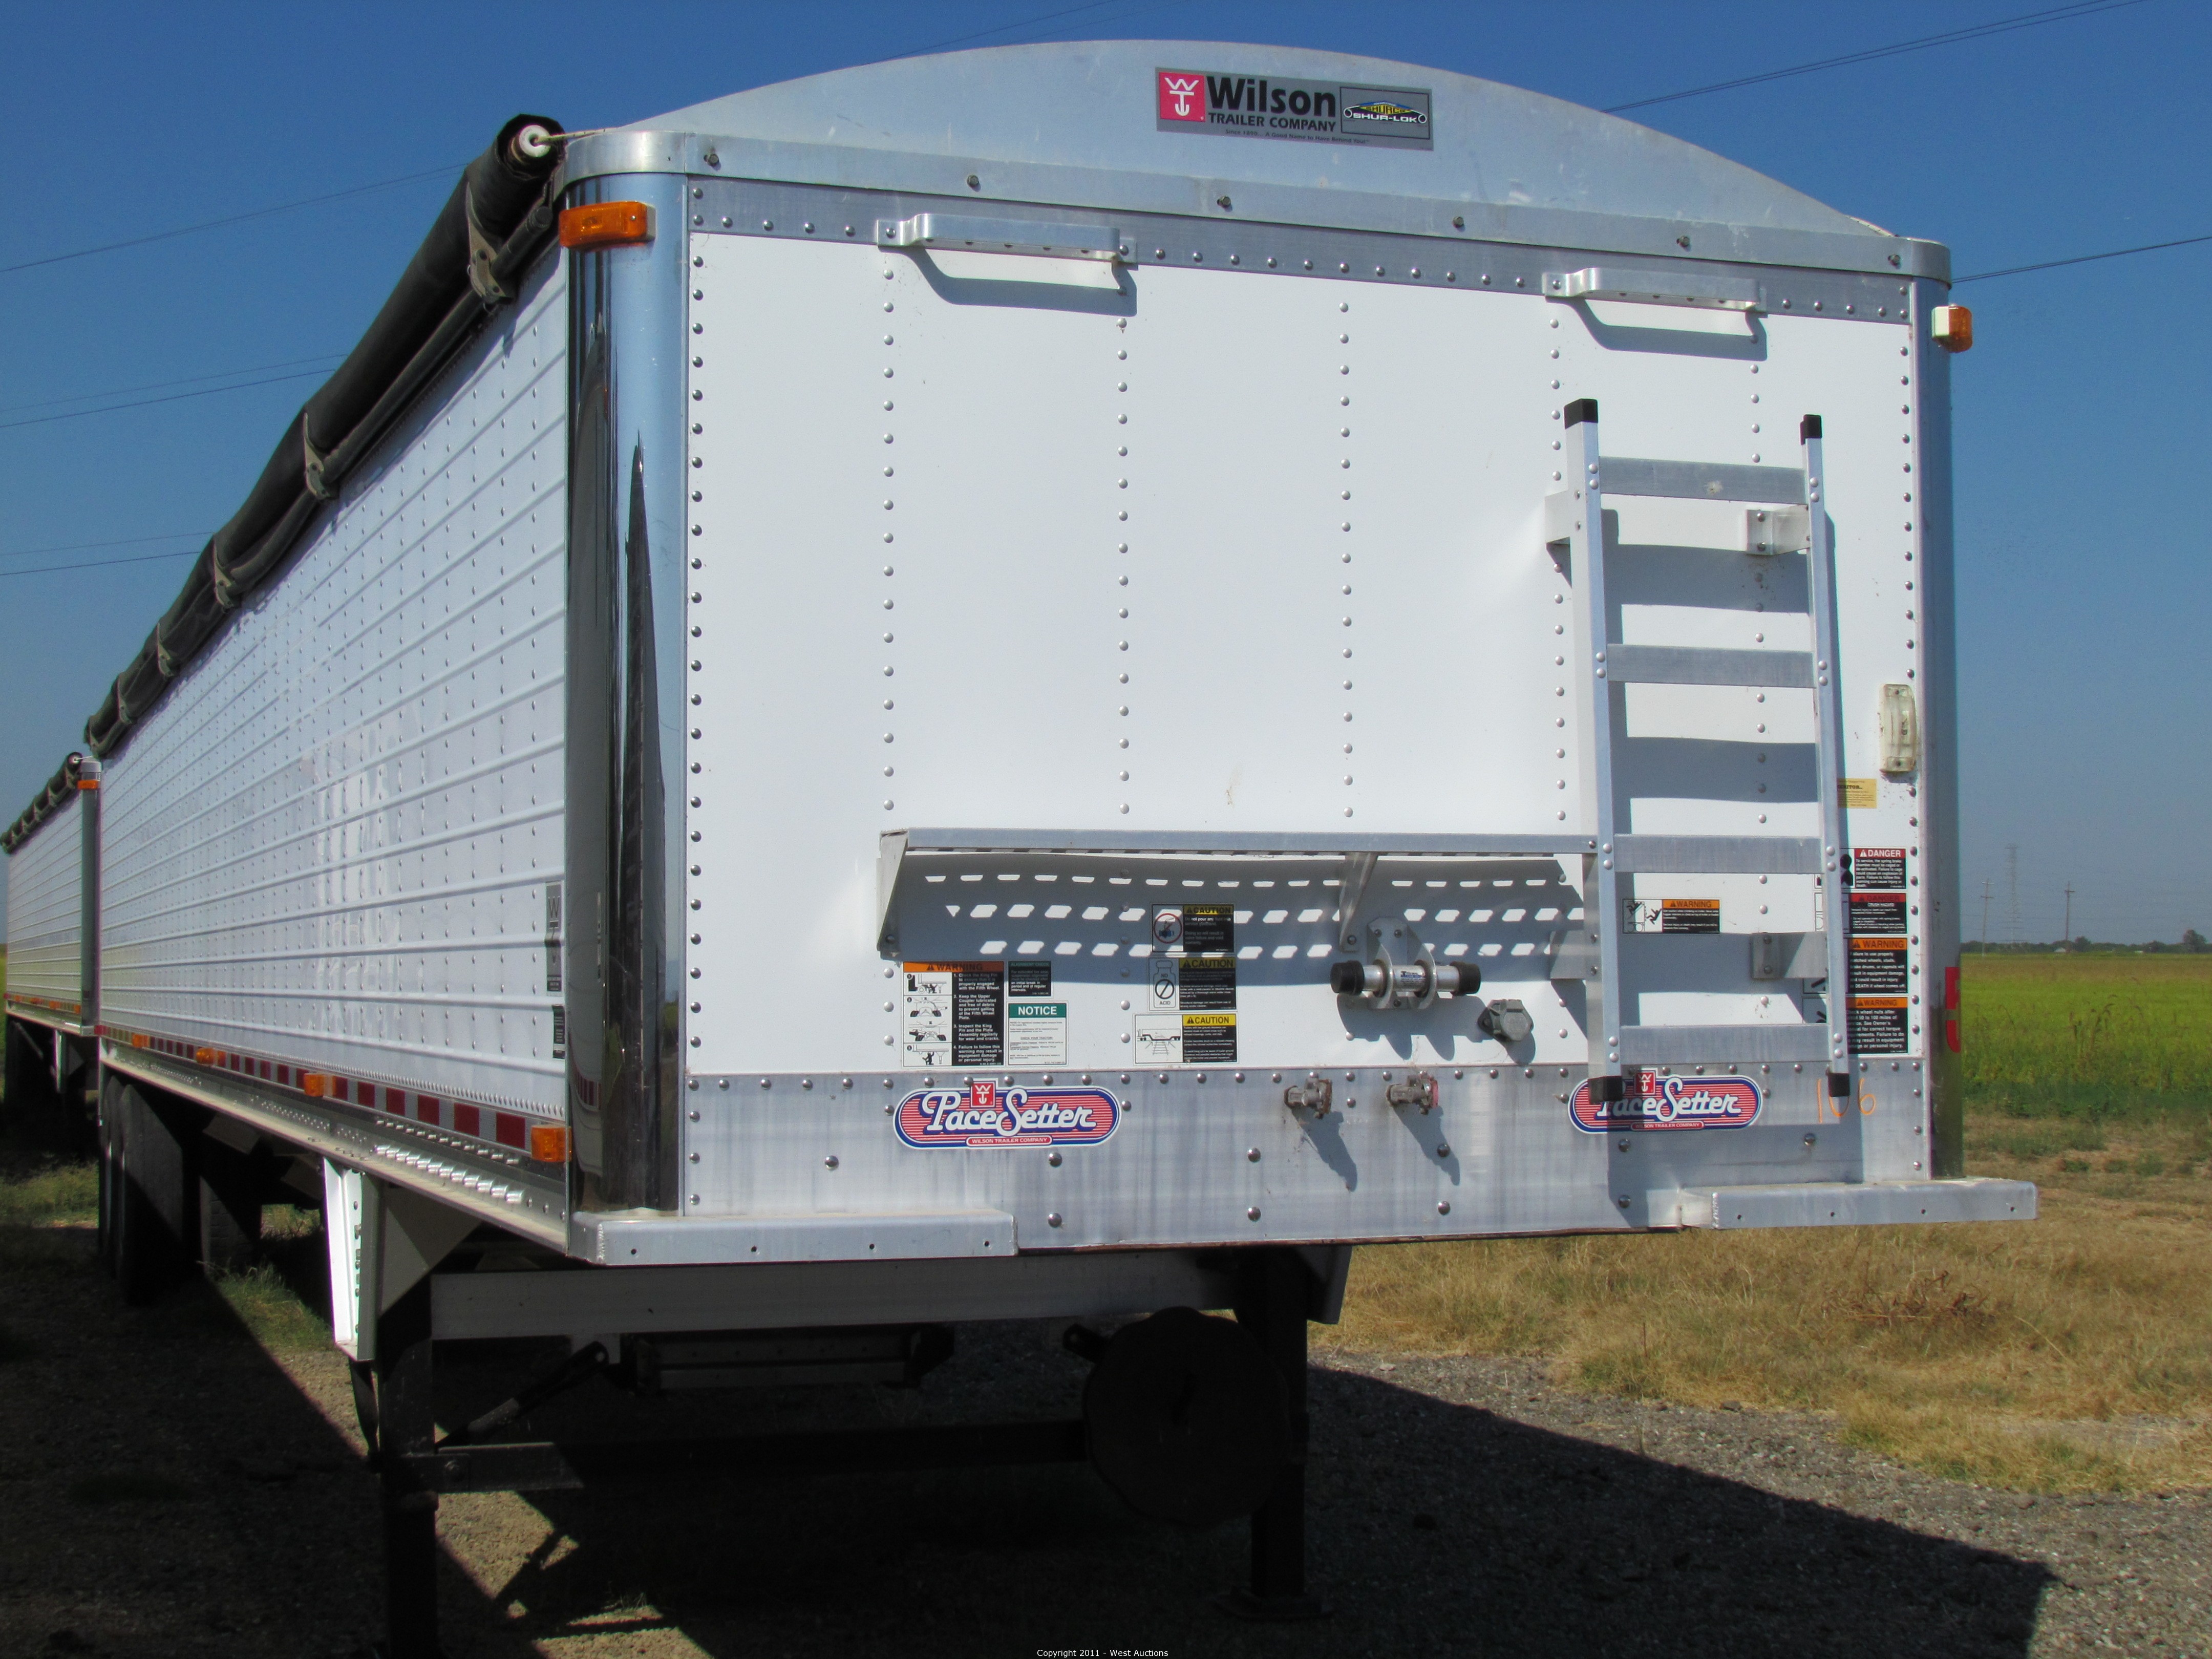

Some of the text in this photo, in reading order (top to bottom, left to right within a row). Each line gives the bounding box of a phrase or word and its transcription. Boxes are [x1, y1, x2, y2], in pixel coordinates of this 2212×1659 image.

[1206, 76, 1336, 118] Wilson
[1208, 112, 1336, 133] TRAILER COMPANY
[1353, 113, 1417, 123] SHUR-LOK
[1018, 1006, 1057, 1015] NOTICE
[922, 1088, 1096, 1136] PaceSetter
